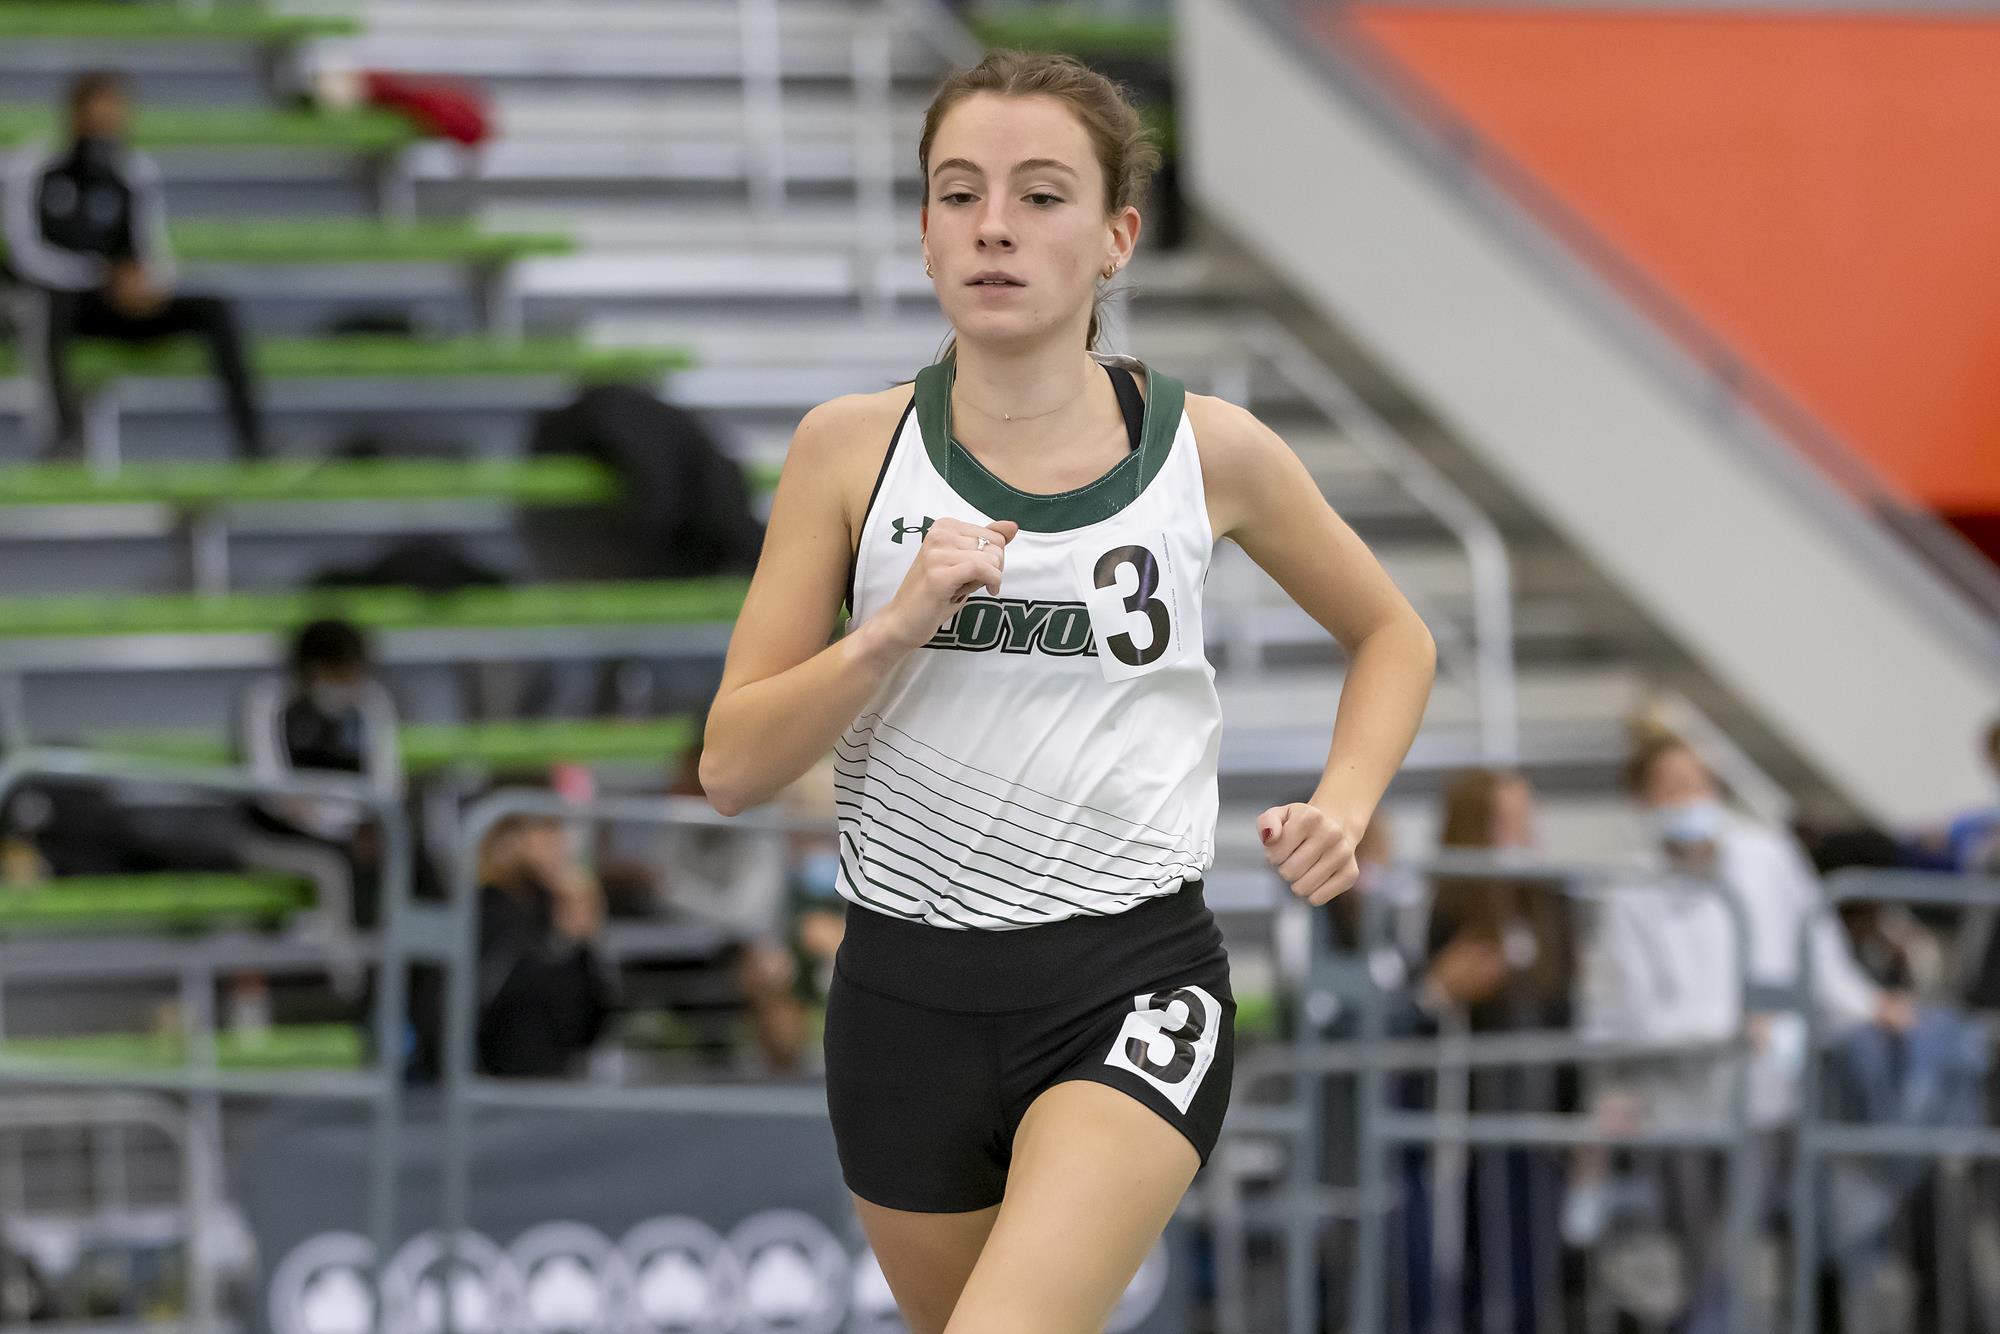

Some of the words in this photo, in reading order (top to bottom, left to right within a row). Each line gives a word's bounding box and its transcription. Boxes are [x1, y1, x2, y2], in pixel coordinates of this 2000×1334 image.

[920, 596, 1099, 657] OYO
[1093, 545, 1171, 667] 3
[1125, 988, 1206, 1084] 3
